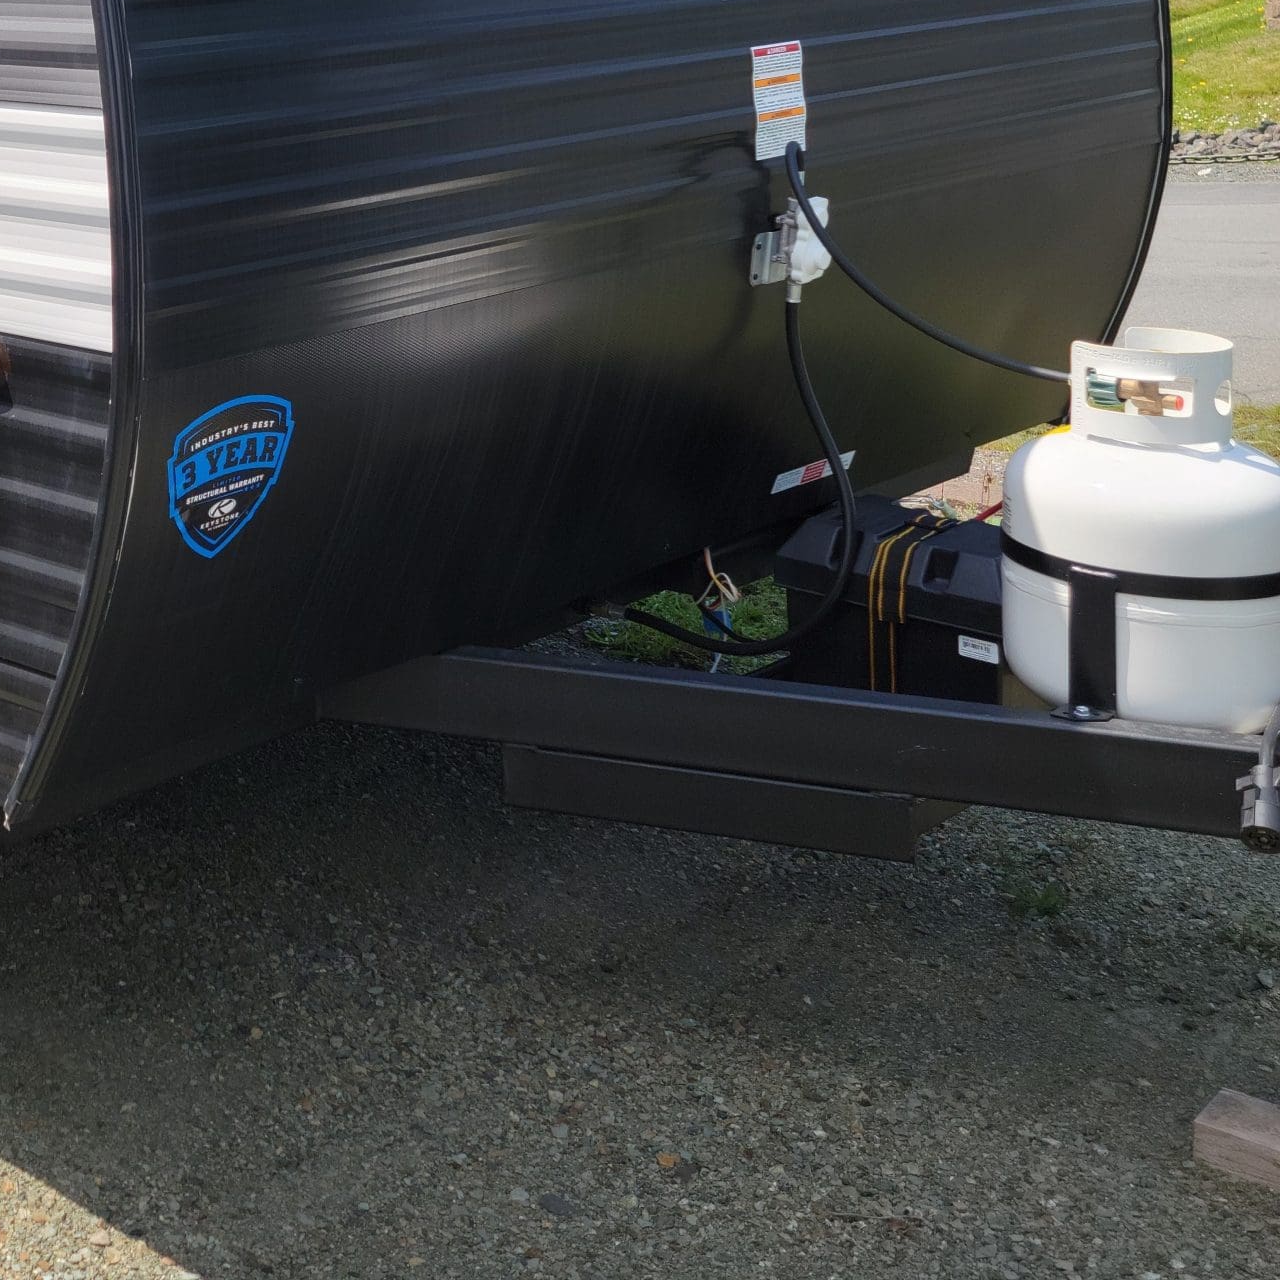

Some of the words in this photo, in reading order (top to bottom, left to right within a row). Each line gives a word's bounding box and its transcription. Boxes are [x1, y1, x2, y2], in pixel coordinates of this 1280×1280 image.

[190, 423, 249, 452] INDUSTRY'S
[252, 420, 275, 429] BEST
[181, 461, 196, 490] 3
[206, 436, 279, 475] YEAR
[186, 486, 227, 505] STRUCTURAL
[229, 474, 265, 491] WARRANTY
[200, 512, 240, 530] KEYSTONE
